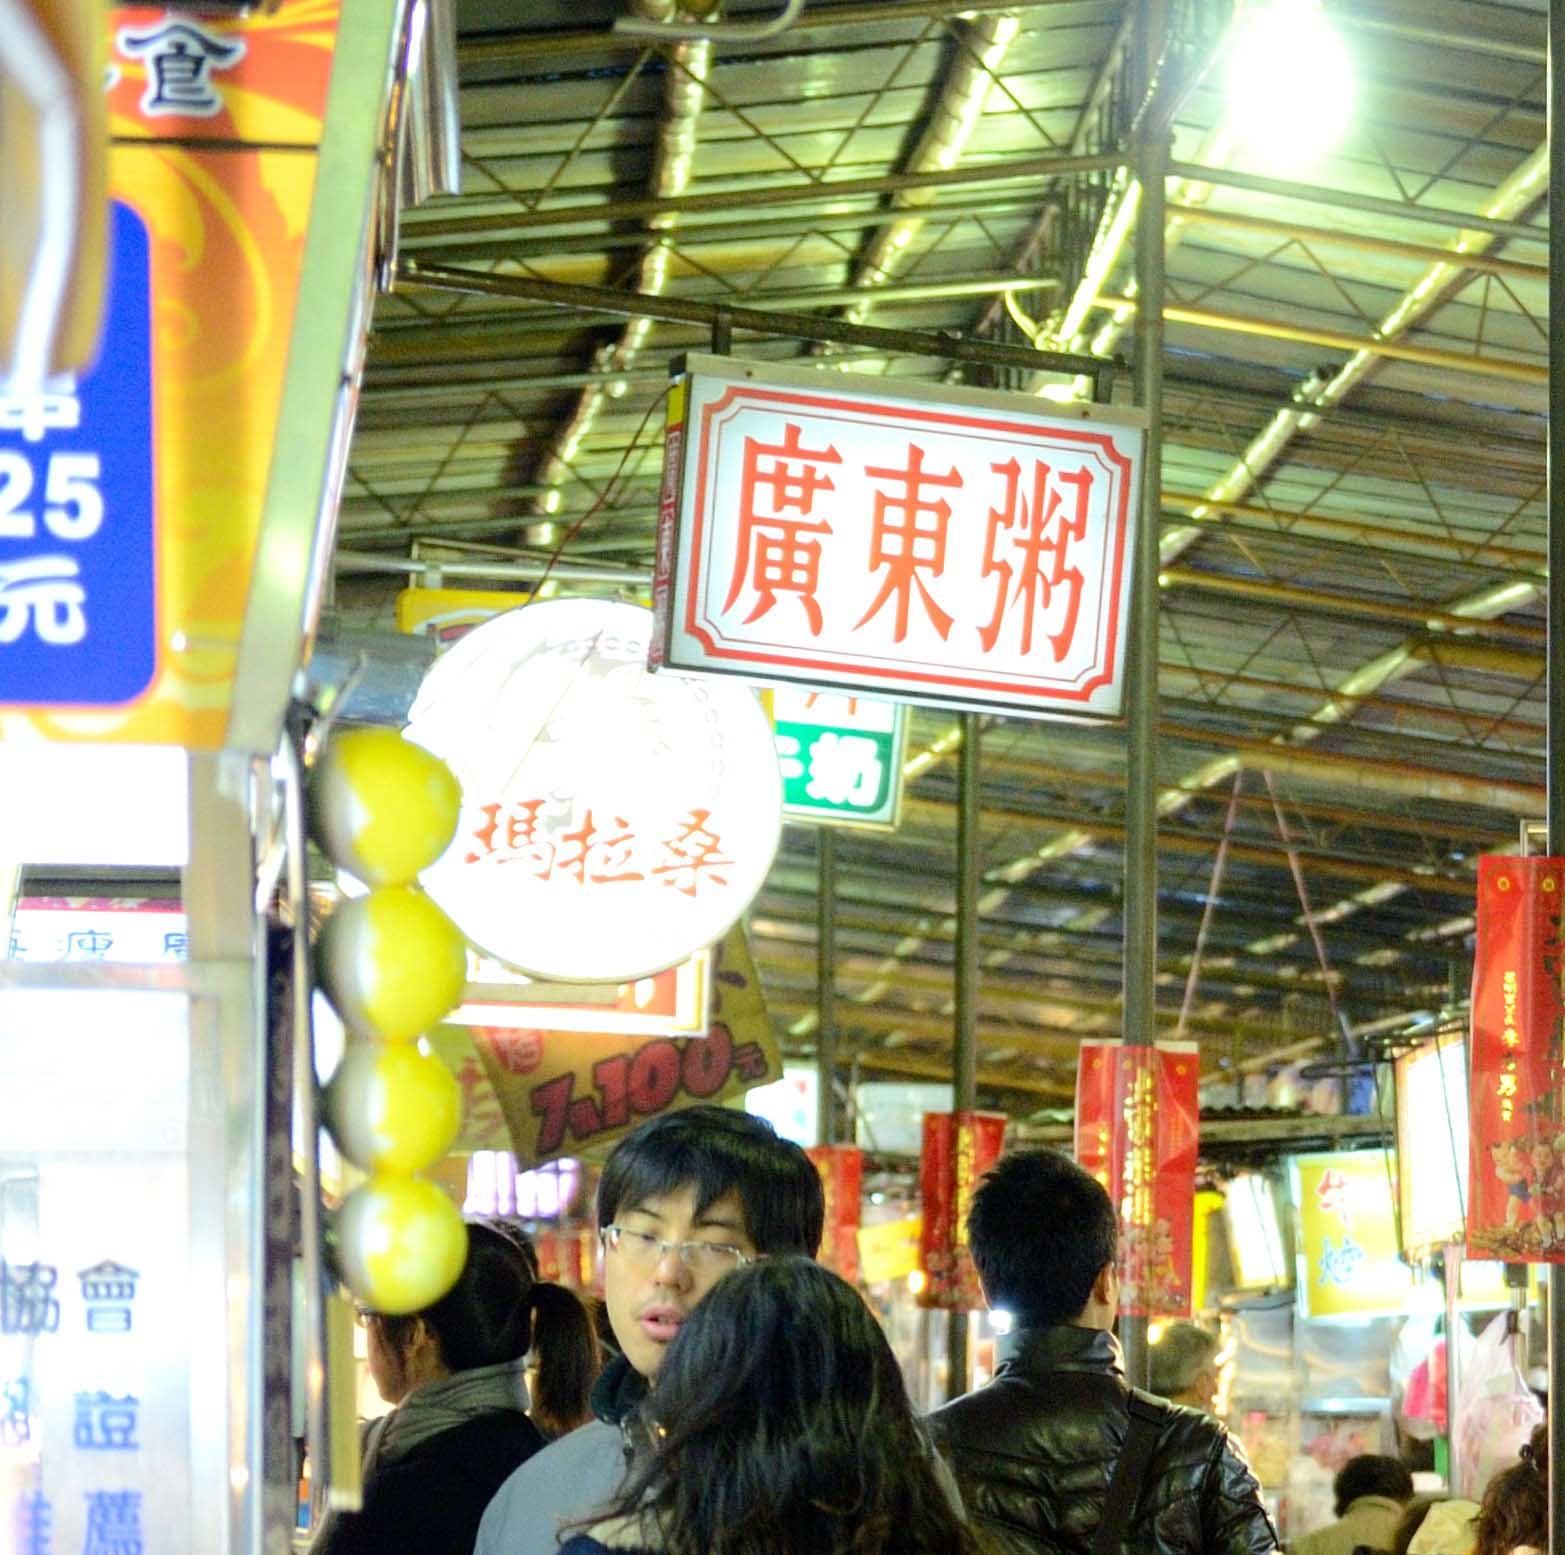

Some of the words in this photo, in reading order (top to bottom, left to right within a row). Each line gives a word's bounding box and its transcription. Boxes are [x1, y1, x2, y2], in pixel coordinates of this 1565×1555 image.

[719, 421, 1096, 664] 廣東粥
[464, 798, 736, 898] 瑪拉桑
